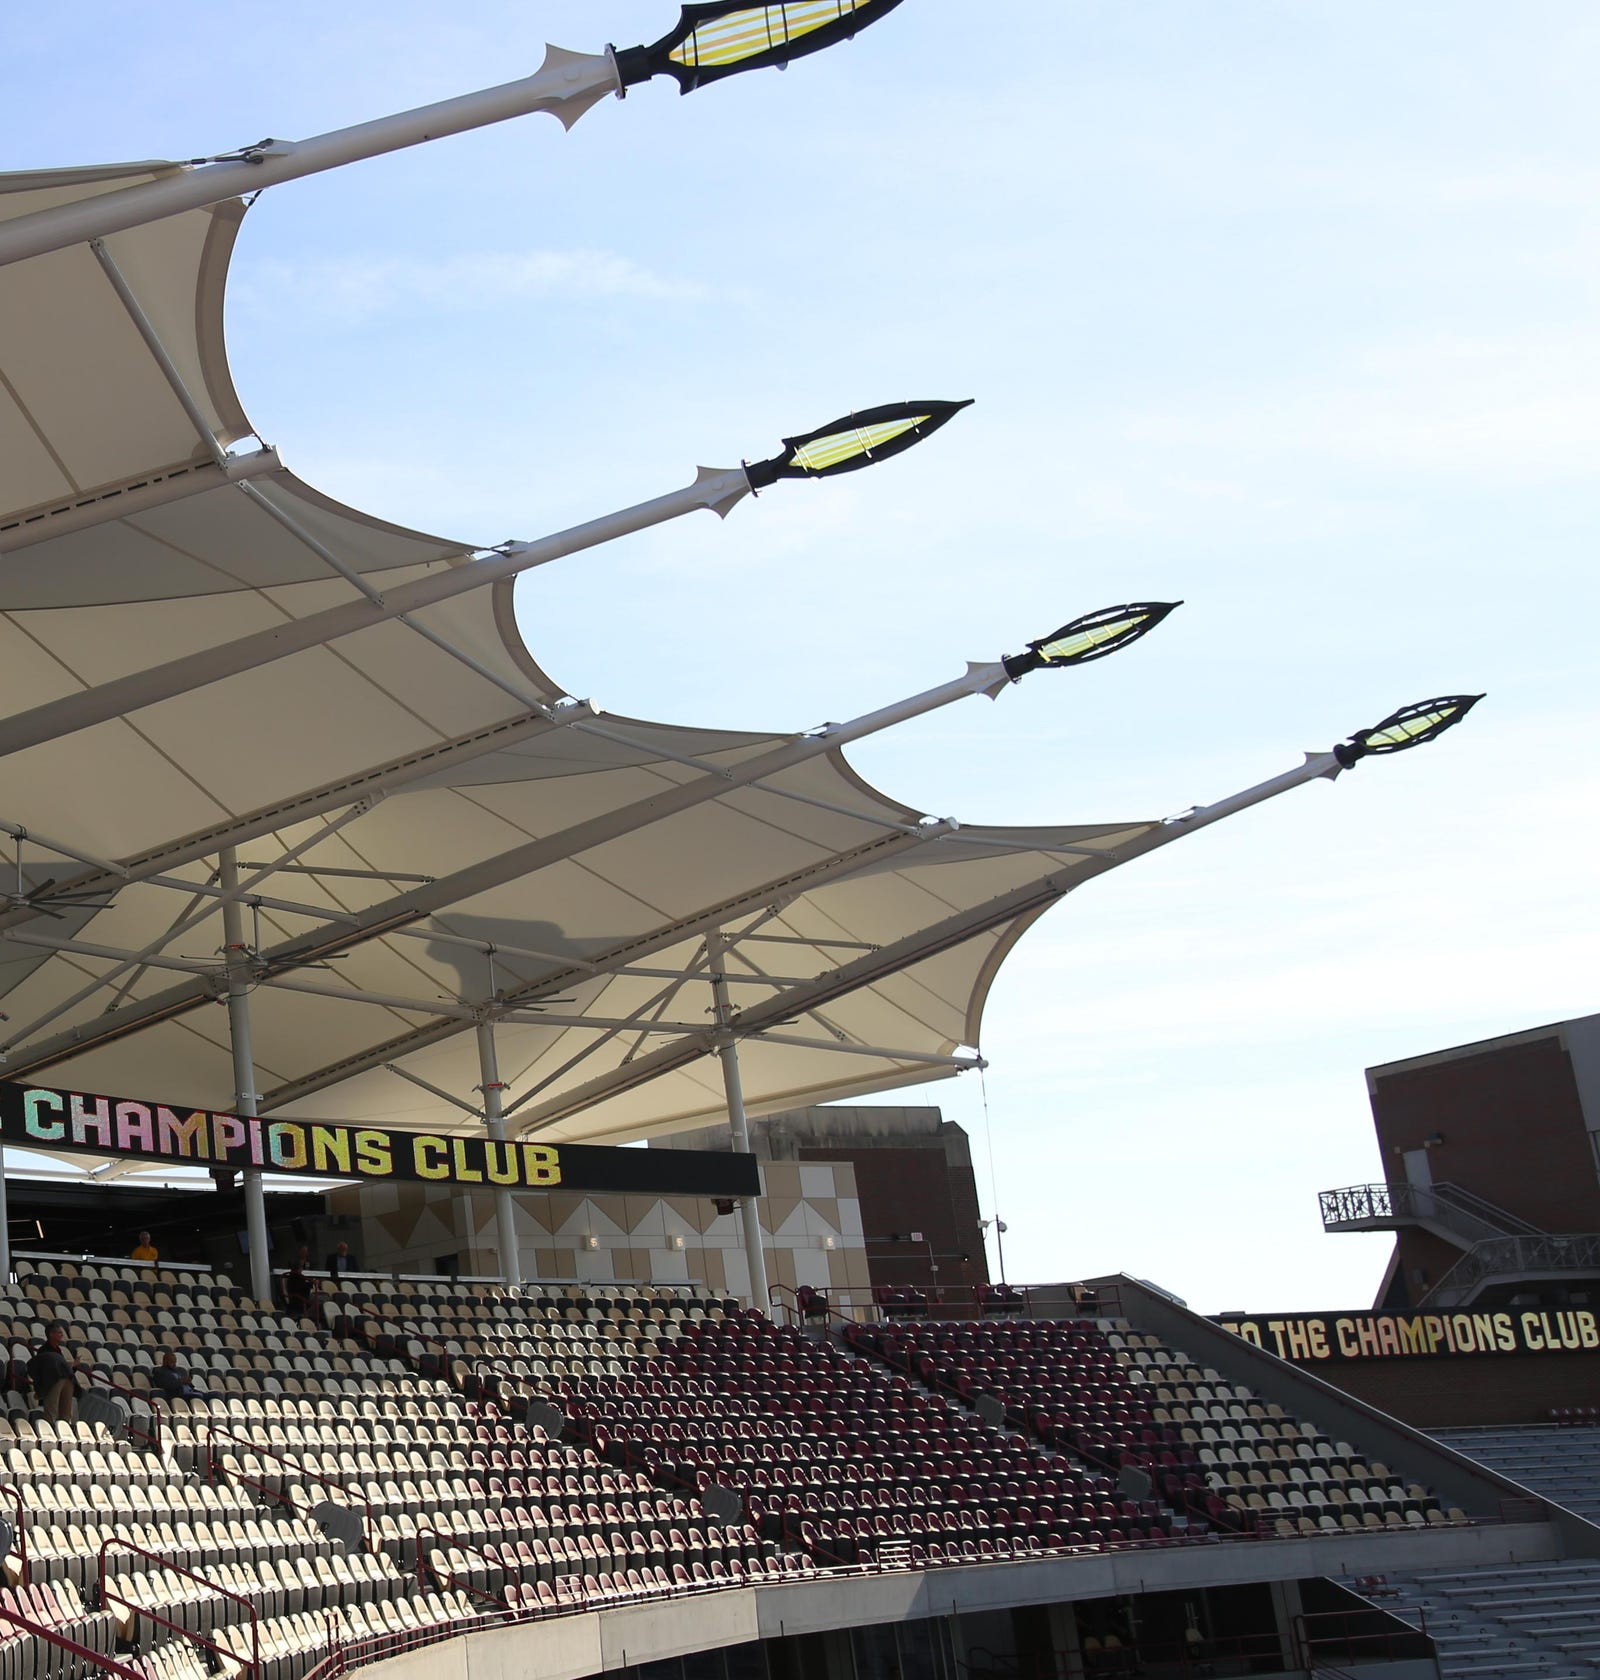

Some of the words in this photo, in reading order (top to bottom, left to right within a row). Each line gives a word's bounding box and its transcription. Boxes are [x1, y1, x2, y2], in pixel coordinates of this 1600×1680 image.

[24, 1089, 392, 1175] CHAMPIONS
[413, 1135, 561, 1186] CLUB
[1268, 1319, 1330, 1359] THE
[1335, 1313, 1516, 1357] CHAMPIONS
[1521, 1311, 1599, 1350] CLUB
